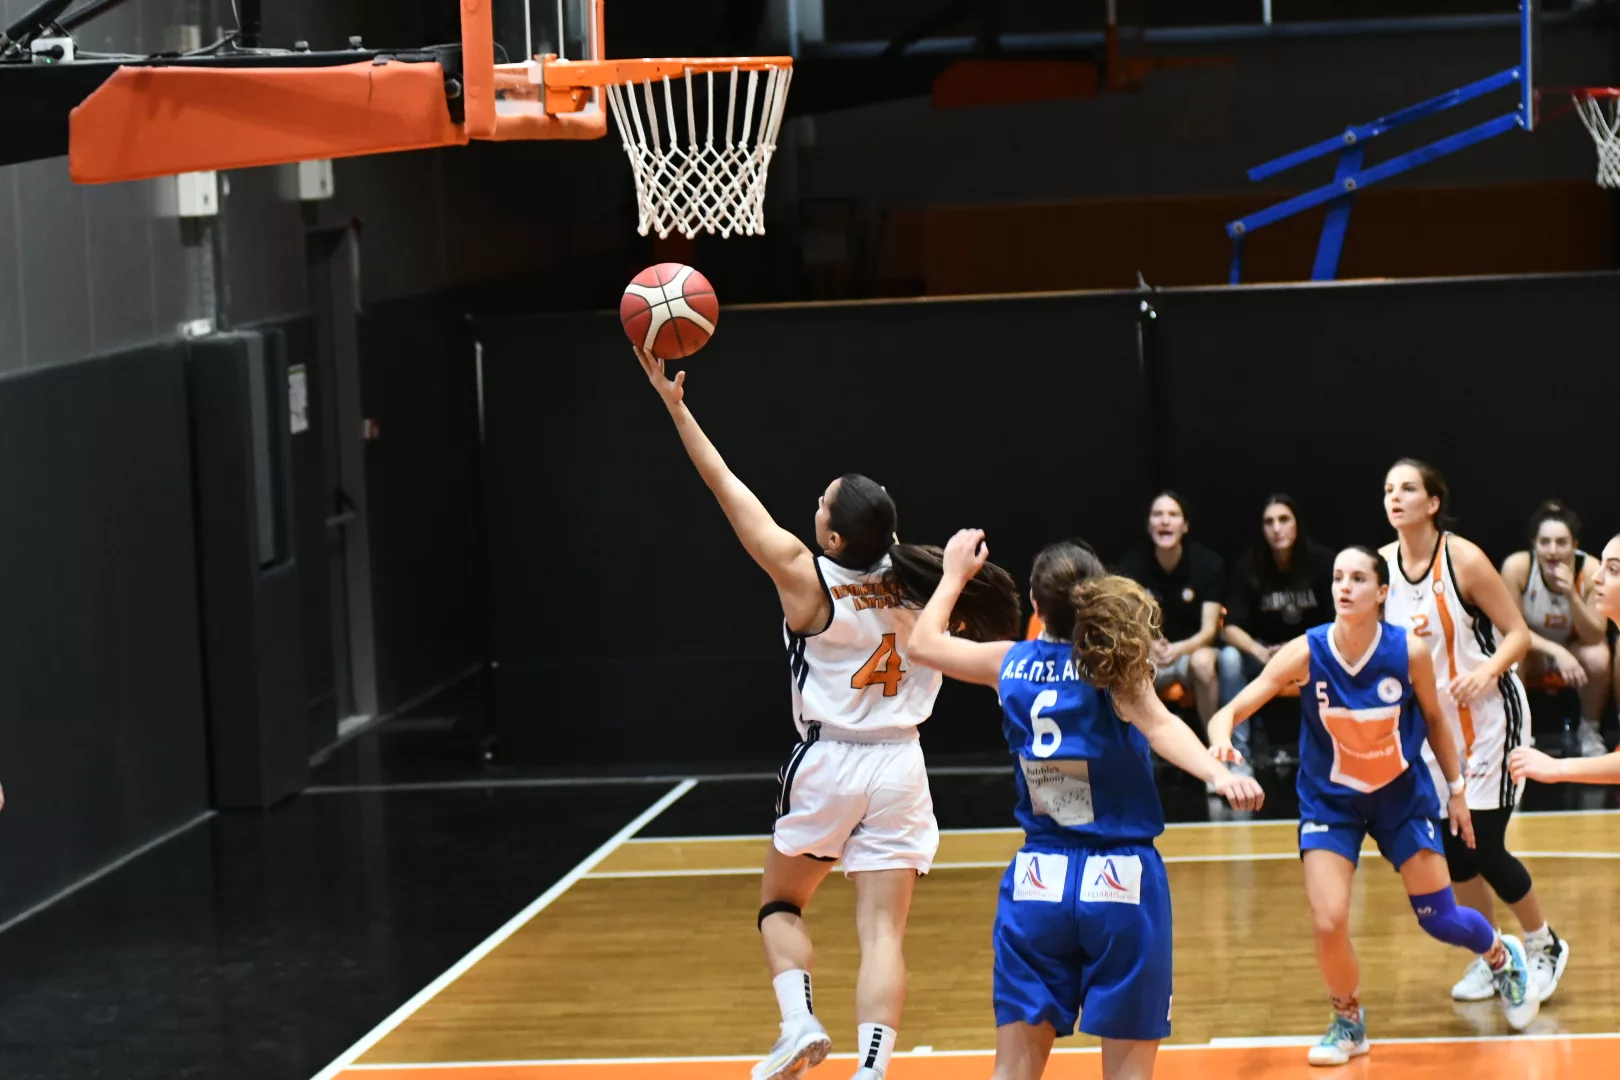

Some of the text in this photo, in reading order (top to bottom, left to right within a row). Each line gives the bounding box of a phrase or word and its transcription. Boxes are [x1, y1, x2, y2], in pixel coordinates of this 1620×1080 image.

[1410, 613, 1433, 638] 2
[850, 632, 907, 697] 4
[1315, 681, 1330, 709] 5
[1029, 689, 1063, 759] 6
